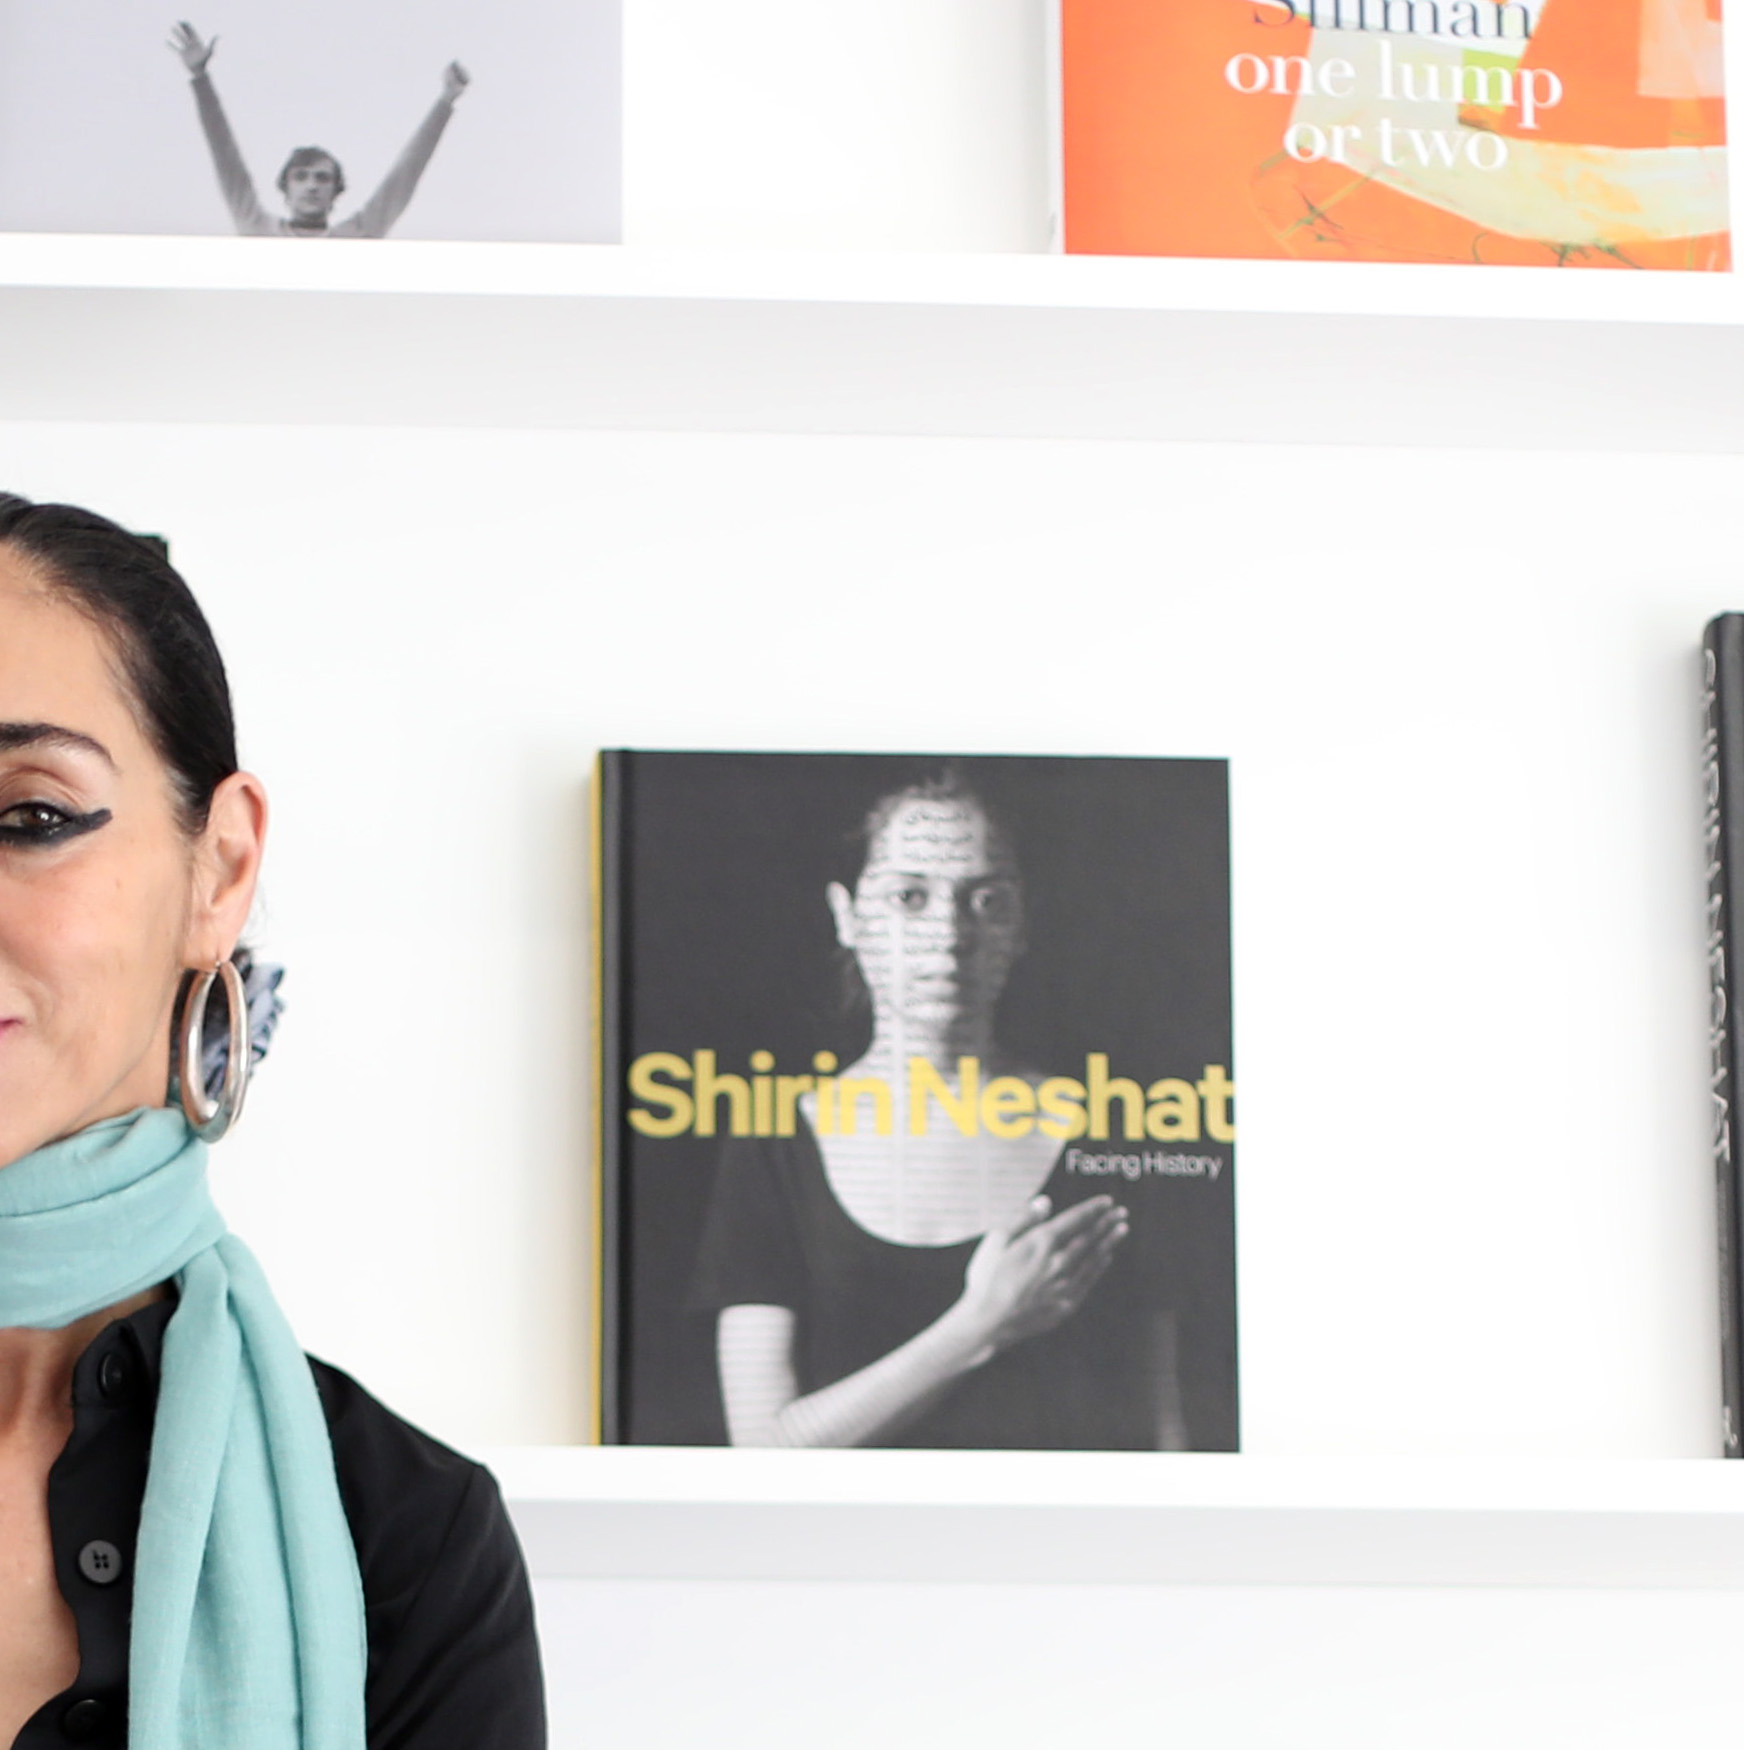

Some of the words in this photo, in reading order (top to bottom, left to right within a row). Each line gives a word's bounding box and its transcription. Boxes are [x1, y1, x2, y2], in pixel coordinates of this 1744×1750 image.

[1224, 48, 1356, 98] one
[1380, 40, 1564, 130] lump
[1284, 118, 1361, 163] or
[1379, 120, 1509, 170] two
[627, 1050, 893, 1138] Shirin
[909, 1053, 1235, 1141] Neshat
[1066, 1149, 1140, 1180] Facing
[1144, 1149, 1222, 1181] History
